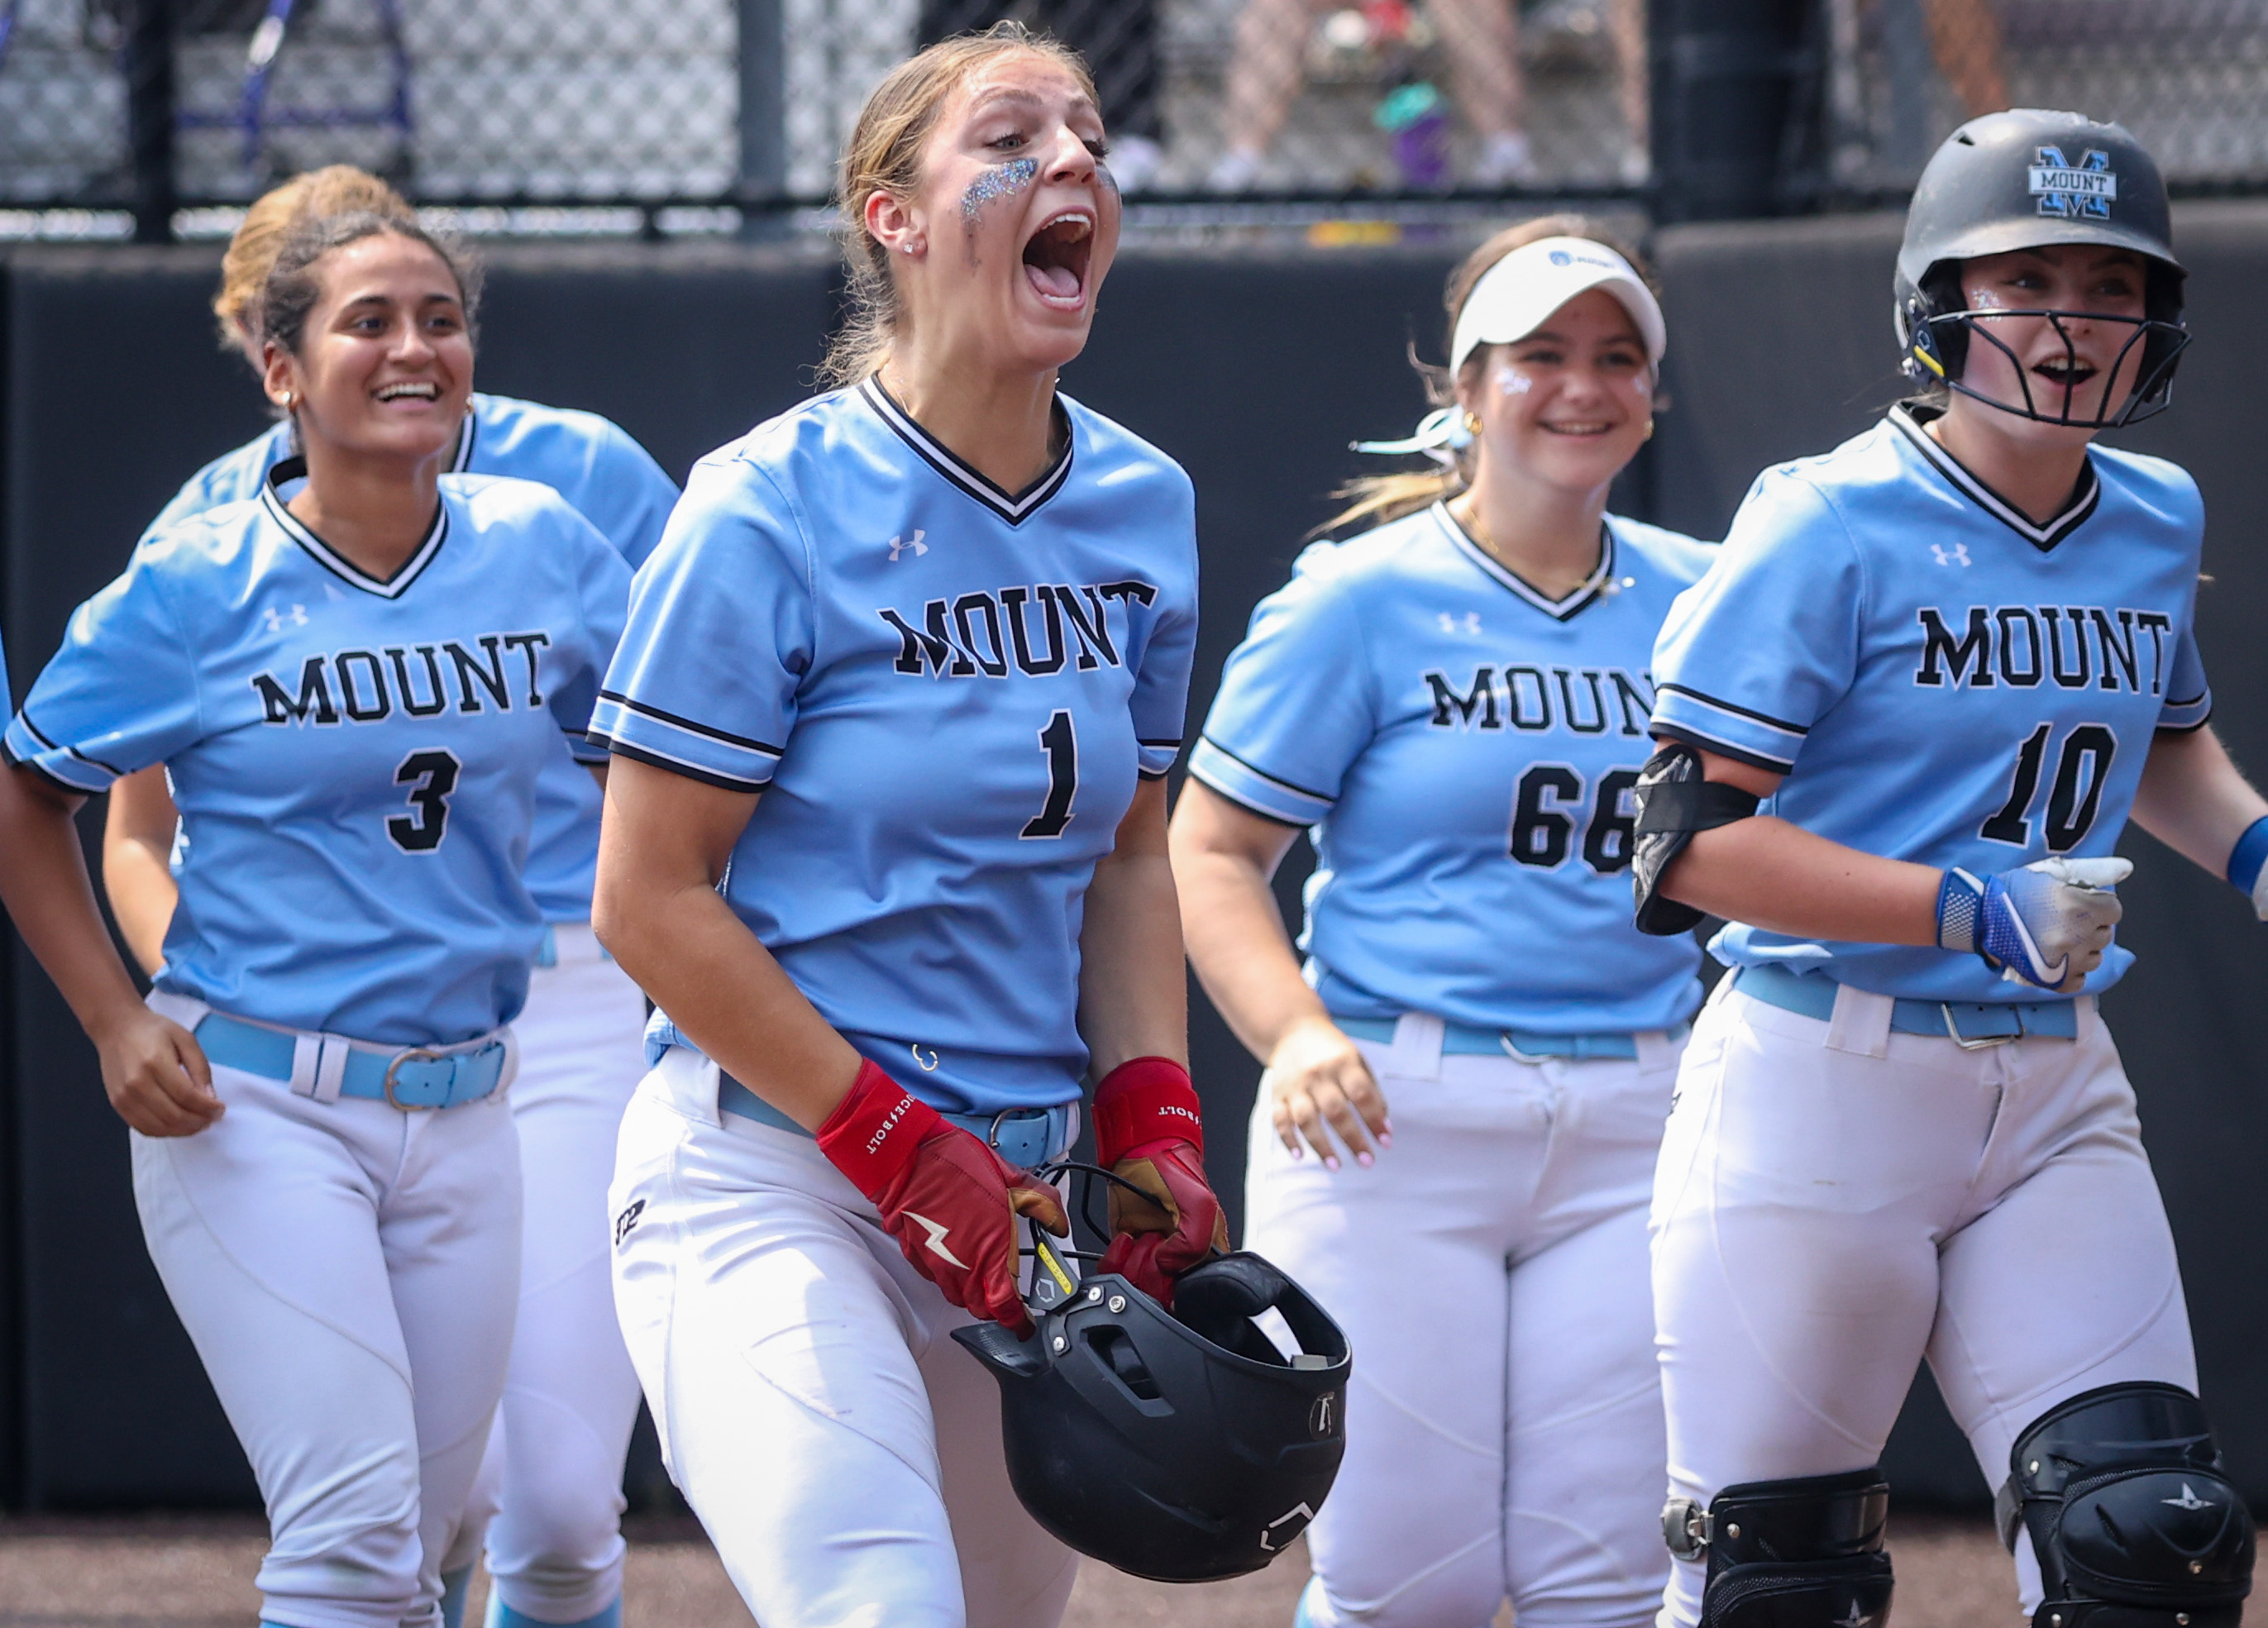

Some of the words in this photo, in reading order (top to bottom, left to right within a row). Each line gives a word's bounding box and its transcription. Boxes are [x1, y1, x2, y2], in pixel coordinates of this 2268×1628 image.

[2041, 171, 2108, 192] MOUNT
[251, 629, 552, 728] MOUNT
[876, 580, 1158, 680] MOUNT
[1913, 604, 2172, 697] MOUNT
[1421, 663, 1654, 737] MOUN
[384, 747, 463, 855] 3
[1018, 708, 1078, 840] 1
[1510, 761, 1636, 874] 66
[1977, 721, 2118, 853] 10
[866, 1120, 894, 1155] BOLT
